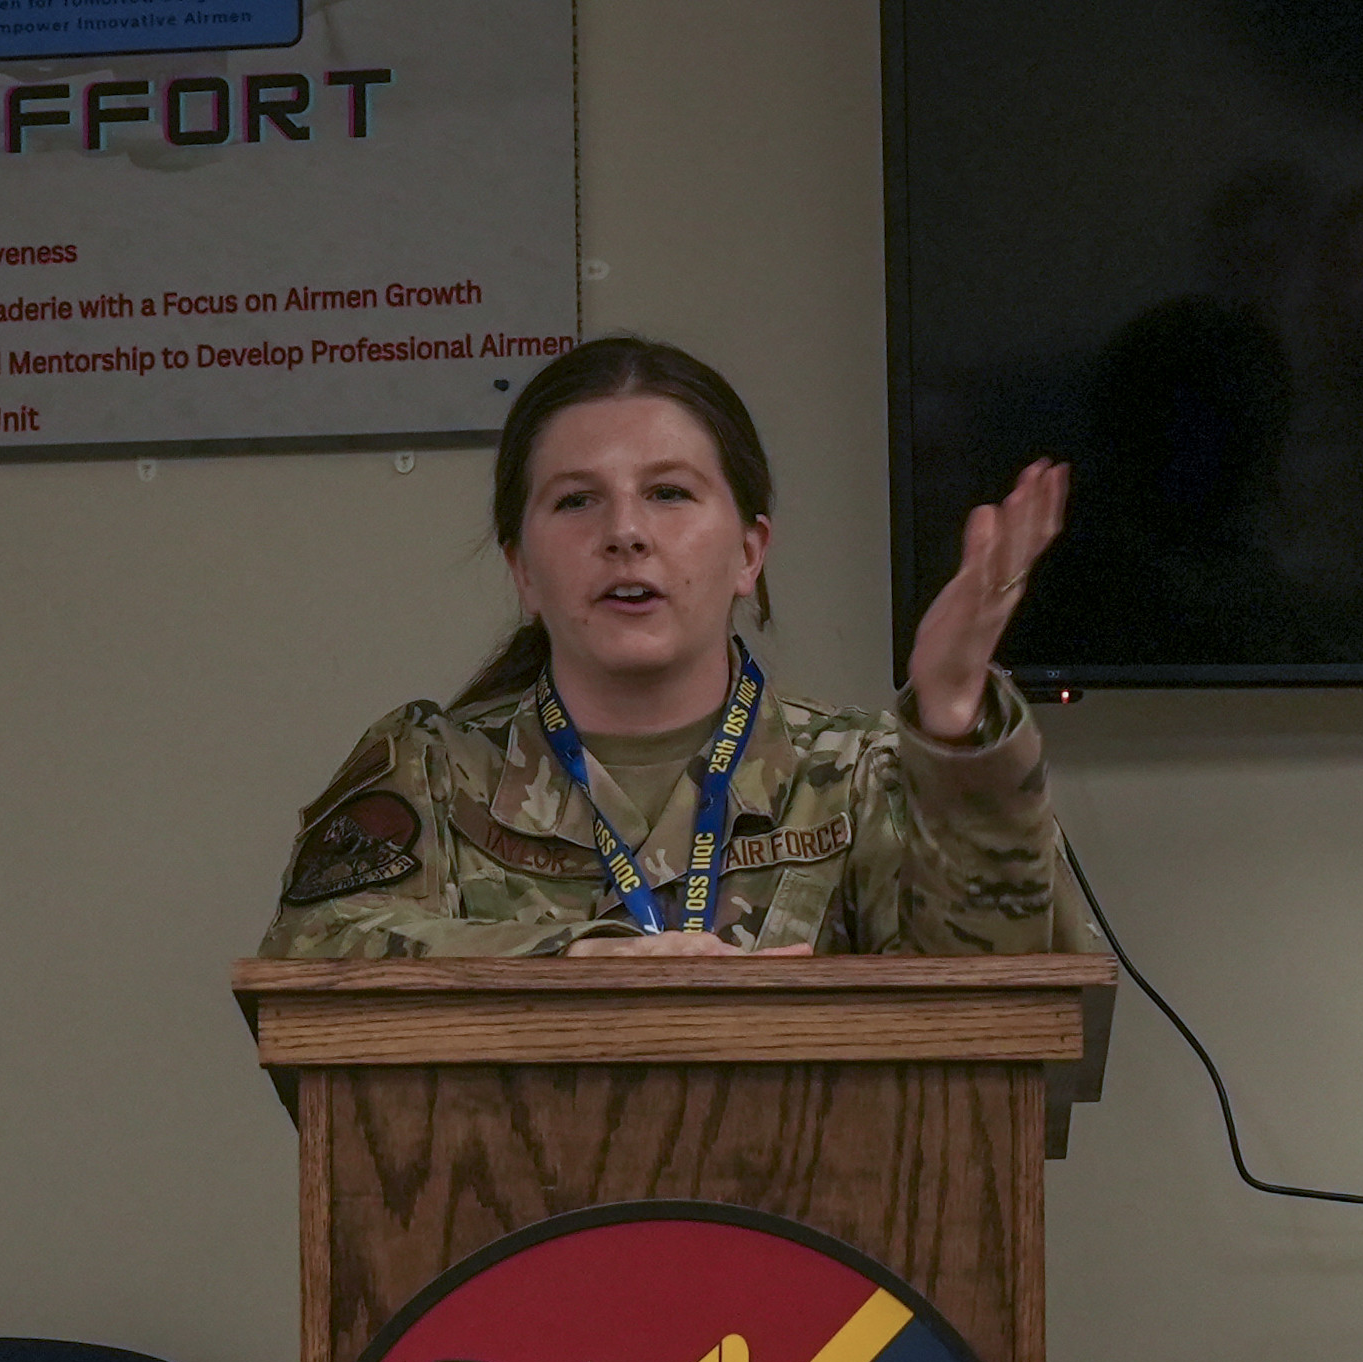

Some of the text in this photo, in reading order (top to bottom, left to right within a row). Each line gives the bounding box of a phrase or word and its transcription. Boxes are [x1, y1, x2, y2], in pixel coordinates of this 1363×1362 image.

[77, 13, 177, 31] Innovative
[184, 10, 253, 25] Airmen
[79, 293, 133, 318] with
[141, 298, 156, 317] a
[164, 292, 238, 316] Focus
[245, 293, 277, 312] on
[285, 287, 377, 311] Airmen
[386, 280, 481, 307] Growth
[9, 346, 155, 376] Mentorship
[161, 348, 189, 369] to
[197, 341, 303, 370] Develop
[312, 334, 473, 363] Professional
[480, 333, 574, 359] Airmen
[722, 704, 749, 737] OSS
[708, 739, 739, 774] 25th
[725, 819, 846, 869] AIR FORCE
[685, 875, 711, 912] OSS
